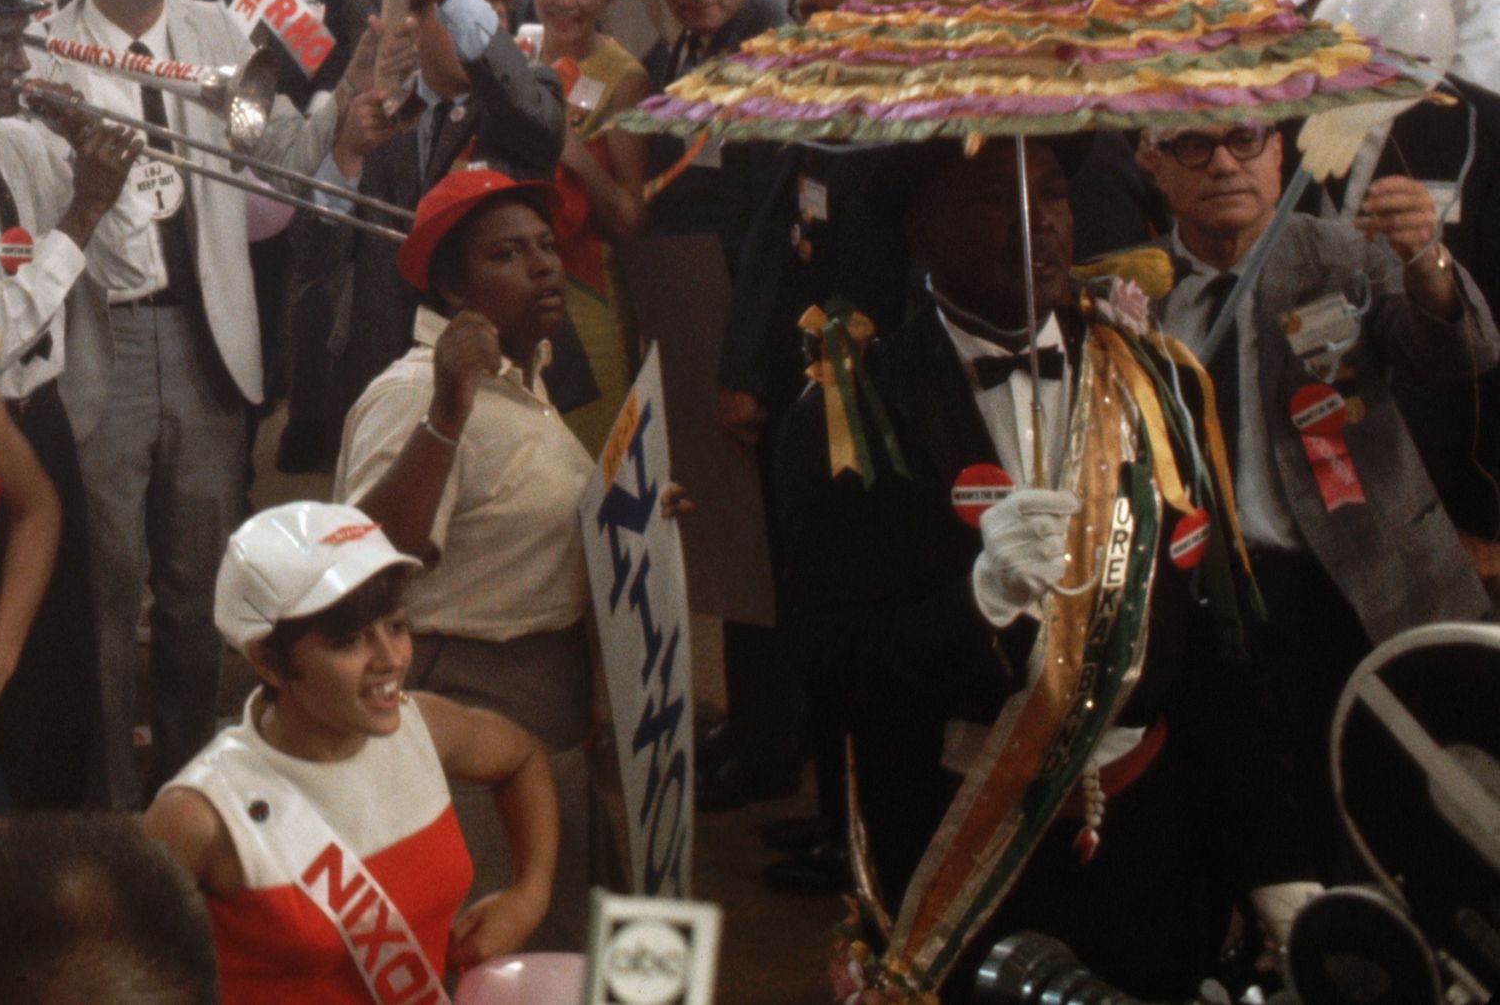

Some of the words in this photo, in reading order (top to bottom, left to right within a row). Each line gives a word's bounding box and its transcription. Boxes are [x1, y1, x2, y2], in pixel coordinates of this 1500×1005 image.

[49, 37, 117, 68] NIXON'S
[119, 49, 155, 74] THE
[155, 57, 204, 83] ONE!
[136, 178, 157, 192] KEEP
[158, 174, 175, 186] OUT
[301, 841, 440, 1005] NIXO
